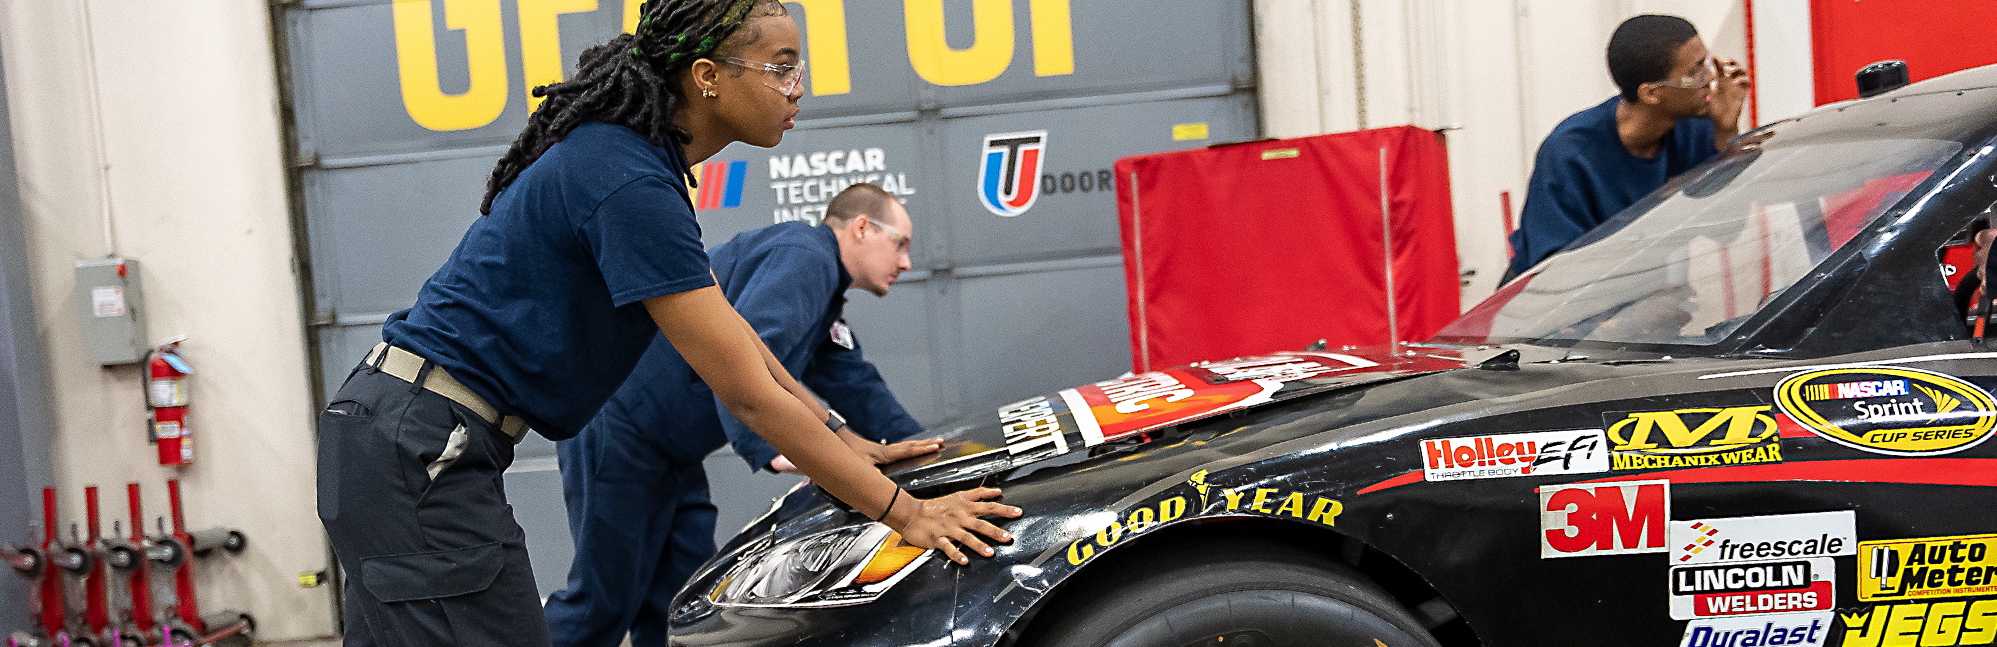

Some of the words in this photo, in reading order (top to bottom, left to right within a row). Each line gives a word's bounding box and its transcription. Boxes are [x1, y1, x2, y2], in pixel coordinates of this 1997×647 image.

[769, 148, 886, 179] NASCAR
[1041, 170, 1113, 195] DOOR
[1838, 380, 1908, 398] NASCAR
[1853, 398, 1925, 421] Sprint
[1870, 432, 1907, 443] CUP
[1912, 428, 1975, 441] SERIES
[1426, 438, 1537, 474] Holley
[1533, 434, 1598, 470] EFI
[1612, 451, 1721, 471] MECHANIX
[1722, 443, 1783, 465] WEAR
[1488, 468, 1519, 476] BODY
[1067, 496, 1186, 566] GOOD
[1222, 487, 1344, 527] YEAR
[1545, 484, 1665, 553] 3M
[1719, 534, 1843, 560] freescale
[1904, 541, 1987, 567] Auto
[1678, 564, 1805, 592] LINCOLN
[1902, 564, 1997, 592] Meter
[1706, 591, 1818, 614] WELDERS
[1687, 619, 1822, 647] Duralast
[1842, 600, 1997, 647] JEGS
